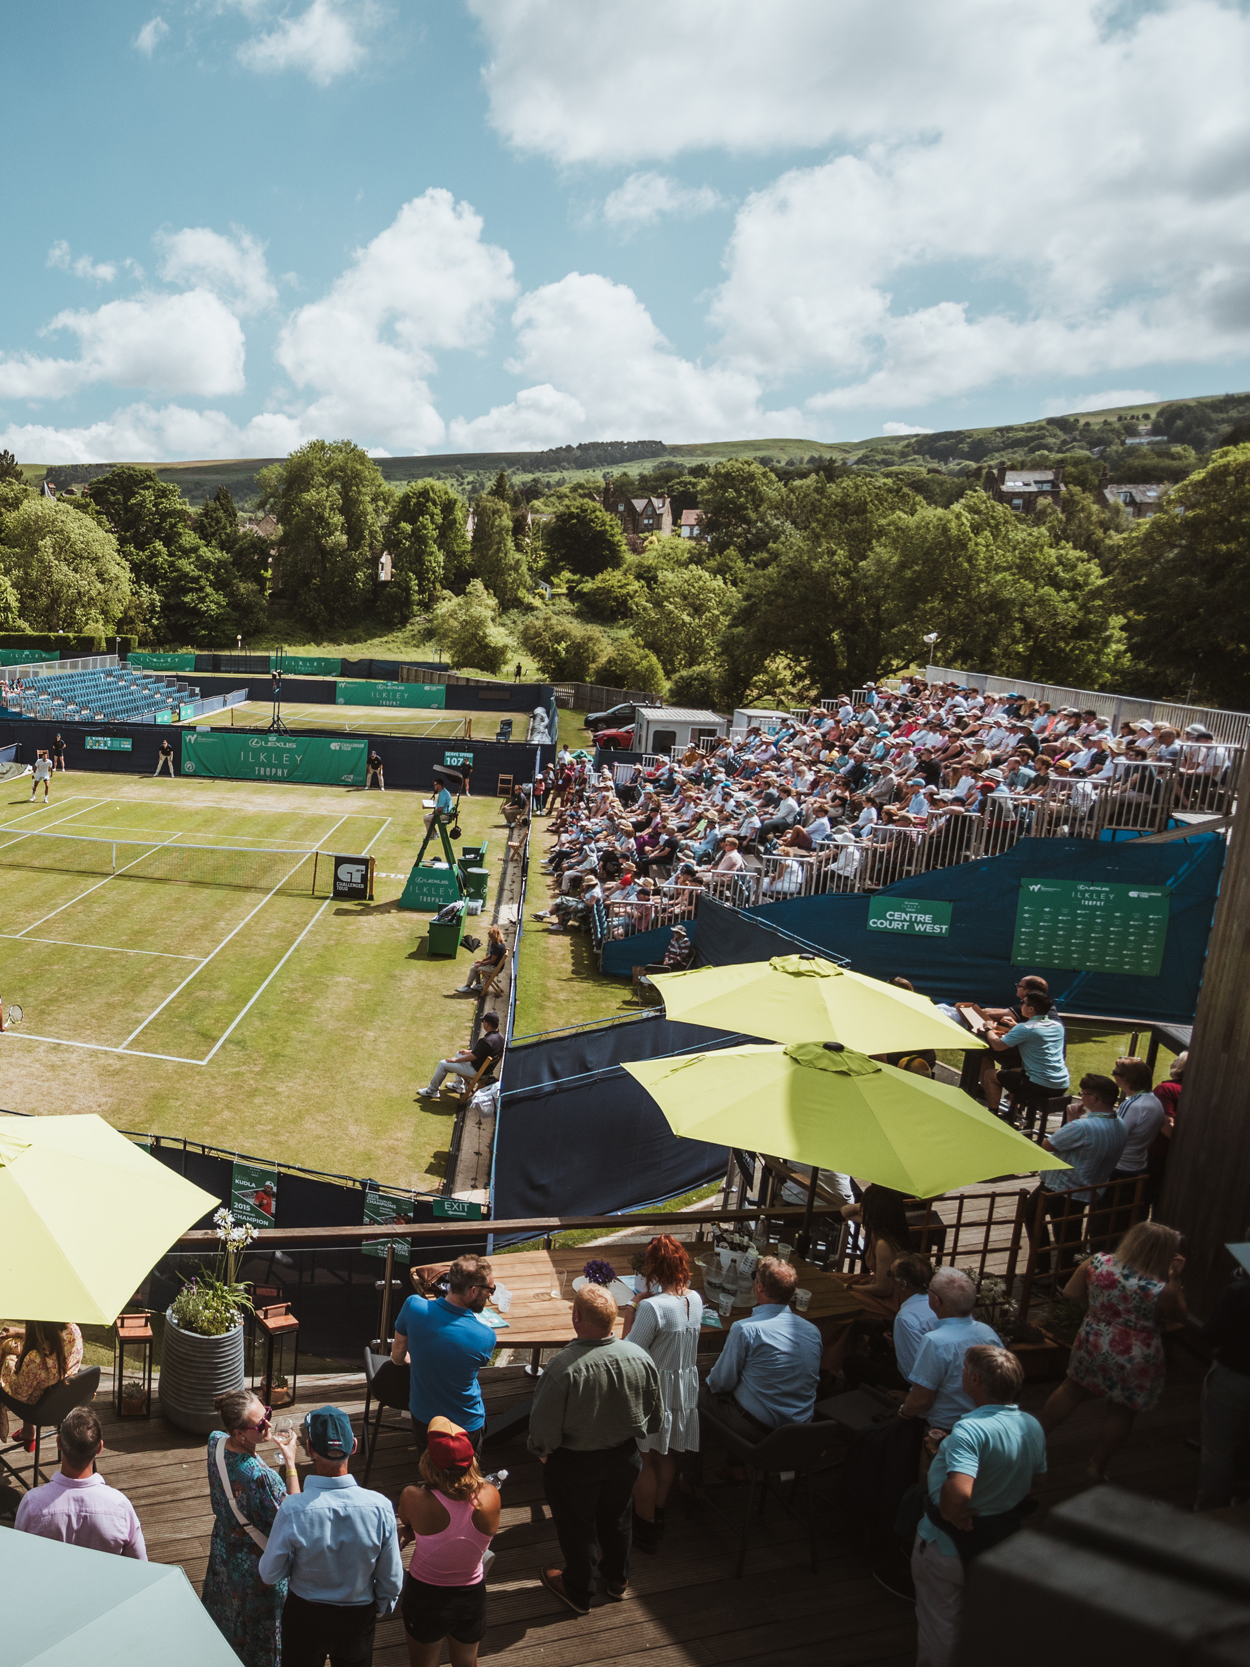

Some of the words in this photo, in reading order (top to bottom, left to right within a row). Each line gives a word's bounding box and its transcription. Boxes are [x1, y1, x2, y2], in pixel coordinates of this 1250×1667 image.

[241, 751, 303, 764] ILKLEY
[446, 757, 464, 766] 107
[255, 767, 288, 776] TROPHY
[336, 881, 364, 889] CHALLENGER
[410, 885, 454, 895] ILKLEY
[1071, 891, 1115, 899] ILKLEY
[886, 911, 933, 923] CENTRE
[869, 918, 910, 930] COURT
[914, 923, 948, 934] WEST
[235, 1179, 256, 1188] KUDLA
[234, 1202, 251, 1211] 2015
[444, 1201, 469, 1212] EXIT
[233, 1213, 269, 1226] CHAMPION
